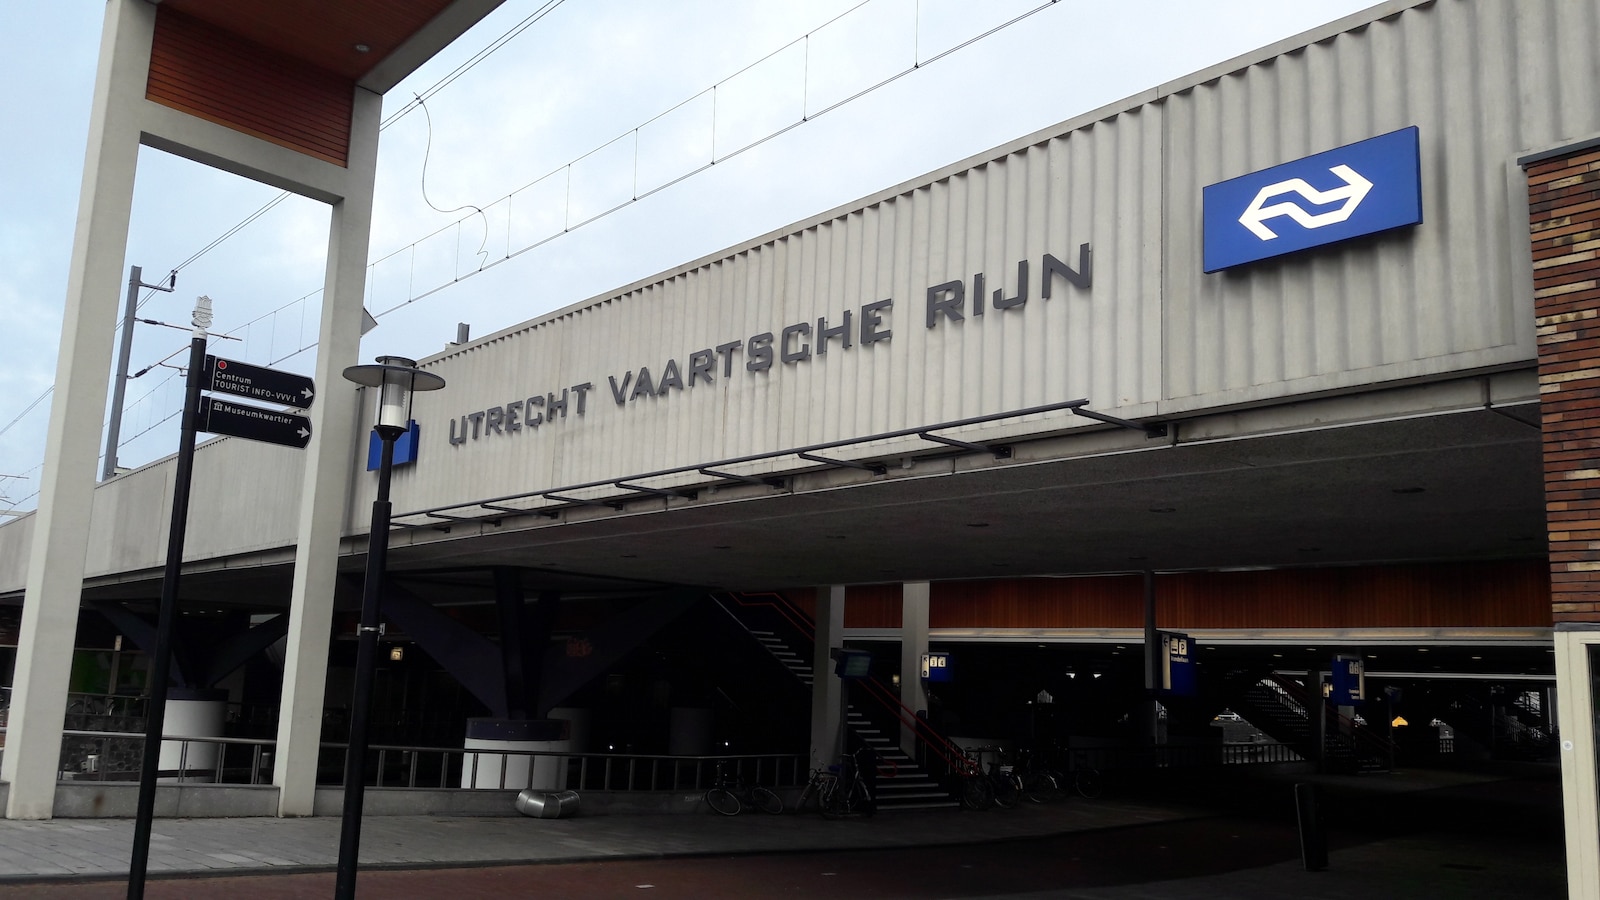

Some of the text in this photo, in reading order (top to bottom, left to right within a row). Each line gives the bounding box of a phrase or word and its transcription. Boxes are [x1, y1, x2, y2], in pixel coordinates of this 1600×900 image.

[449, 242, 1093, 447] UTRECHT VAARTSCHE RIJN
[216, 371, 251, 385] Centrum
[215, 380, 250, 393] TOURIST
[224, 405, 293, 424] Museumkwartier
